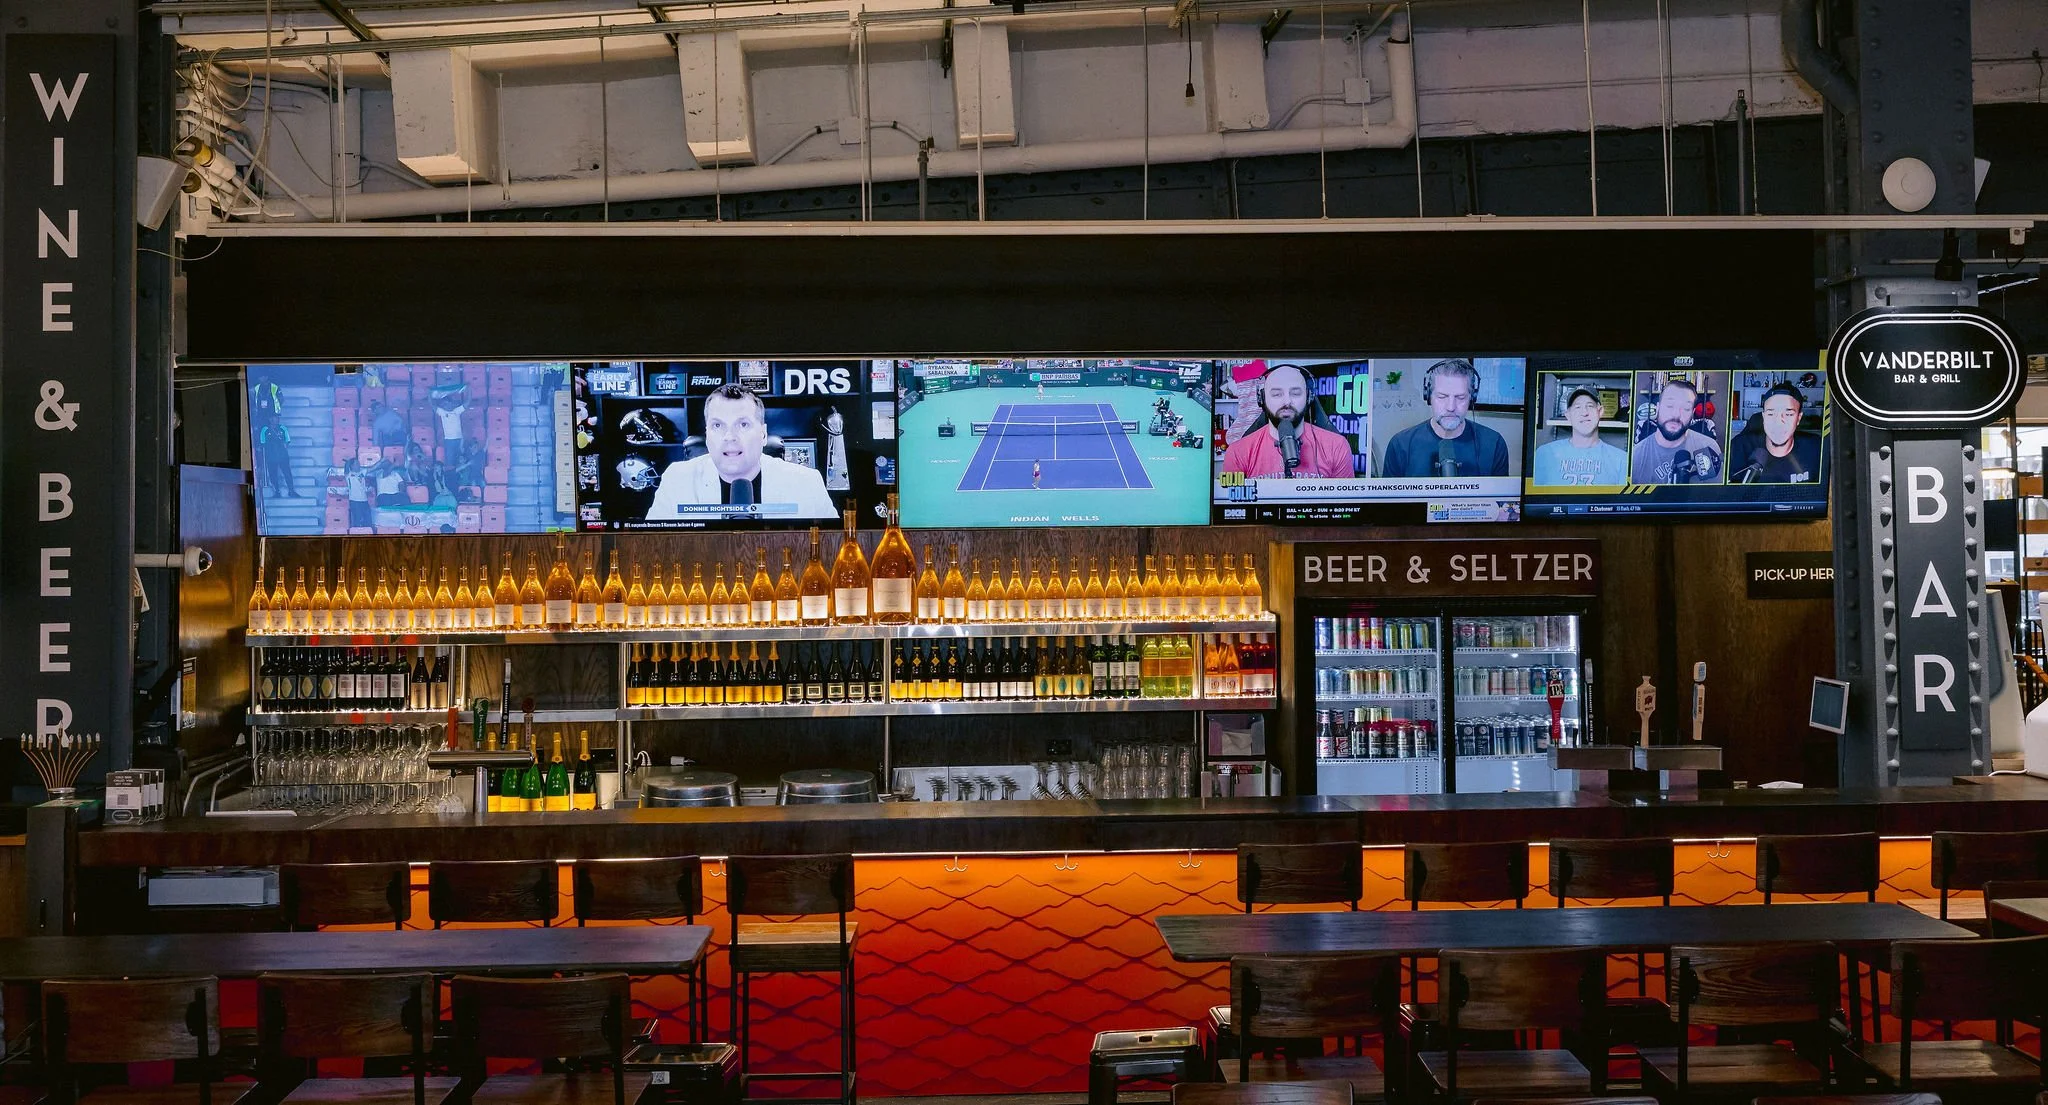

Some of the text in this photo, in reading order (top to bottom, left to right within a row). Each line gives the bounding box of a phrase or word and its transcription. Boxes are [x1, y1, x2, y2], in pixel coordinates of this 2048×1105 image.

[1859, 351, 1994, 370] VANDERBILT
[593, 381, 626, 391] LINE
[784, 368, 851, 395] DRS
[1894, 374, 1961, 384] BAR & GRILL
[29, 72, 89, 748] WINE & BEER
[1304, 553, 1593, 583] BEER & SELTZER
[1754, 568, 1835, 581] PICK-UP HER
[1907, 466, 1957, 712] BAR
